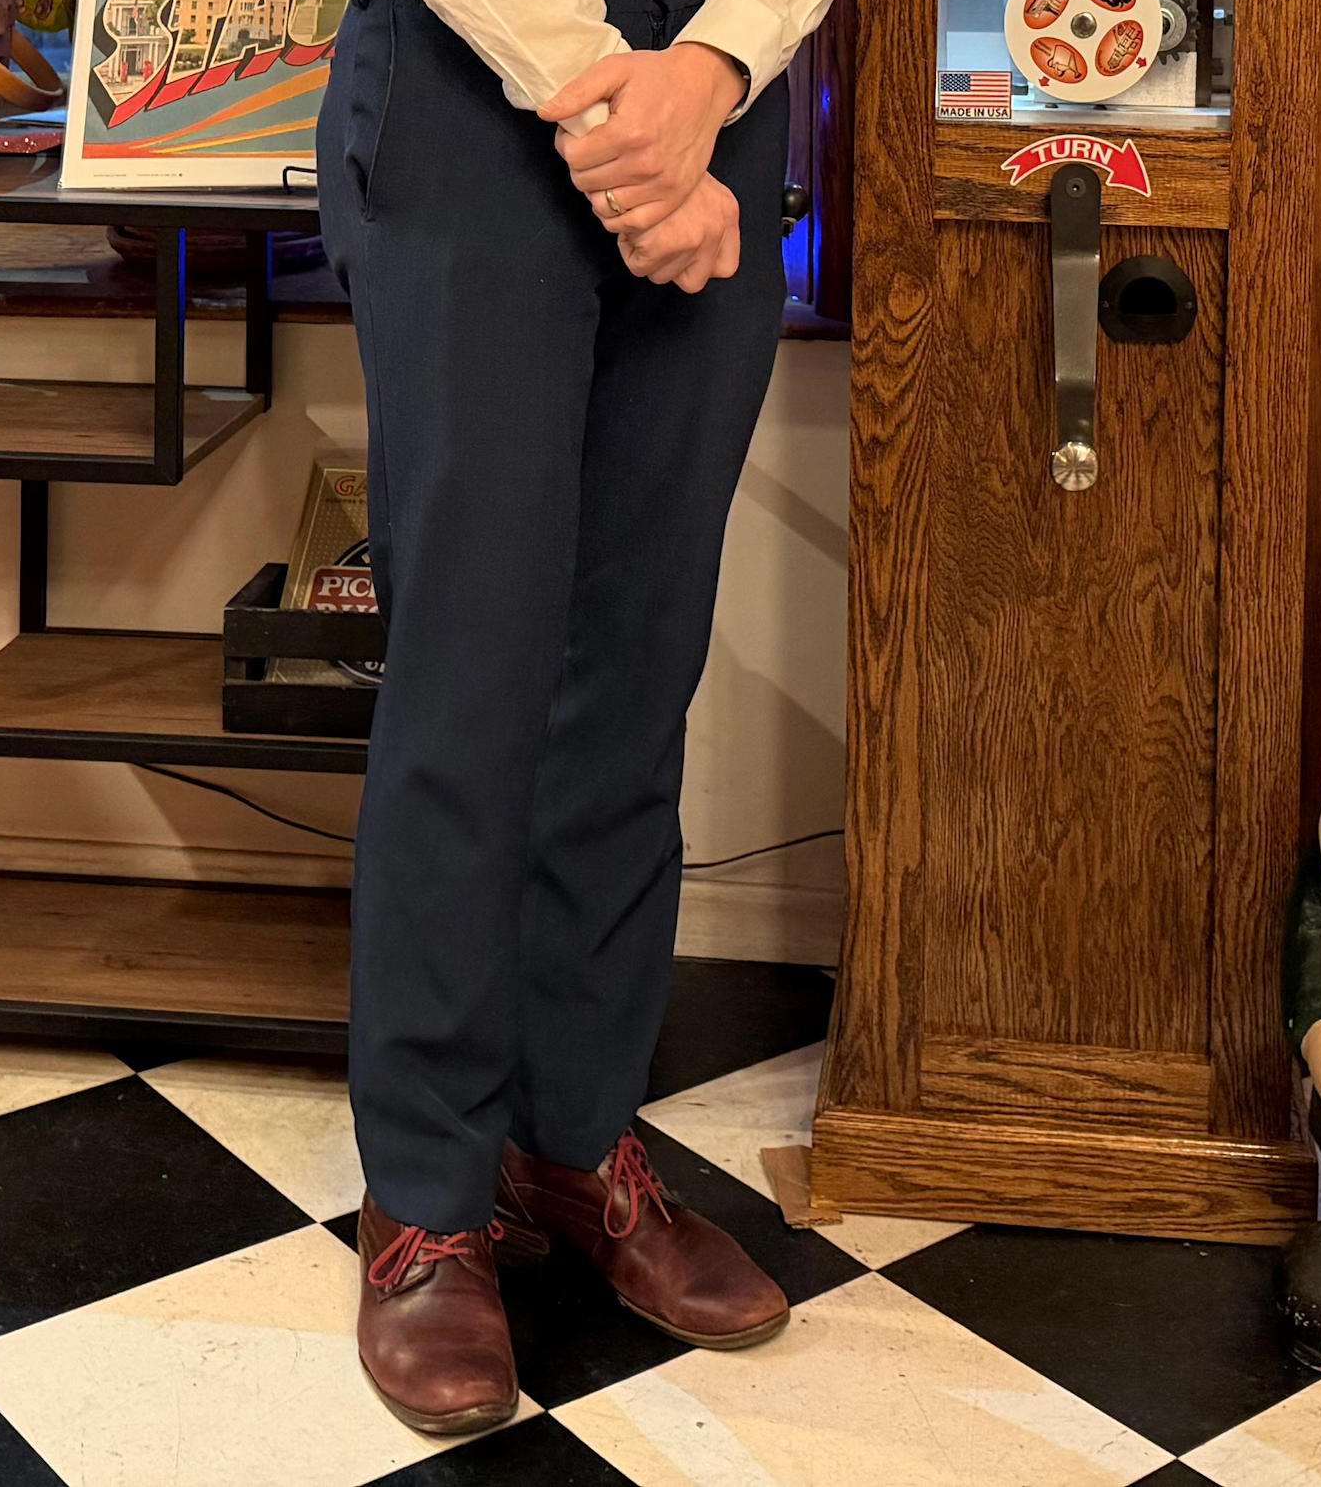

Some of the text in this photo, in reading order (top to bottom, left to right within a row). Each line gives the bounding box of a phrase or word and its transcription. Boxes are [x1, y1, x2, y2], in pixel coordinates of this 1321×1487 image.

[940, 108, 1009, 118] MADE IN USA
[1031, 140, 1114, 165] TURN
